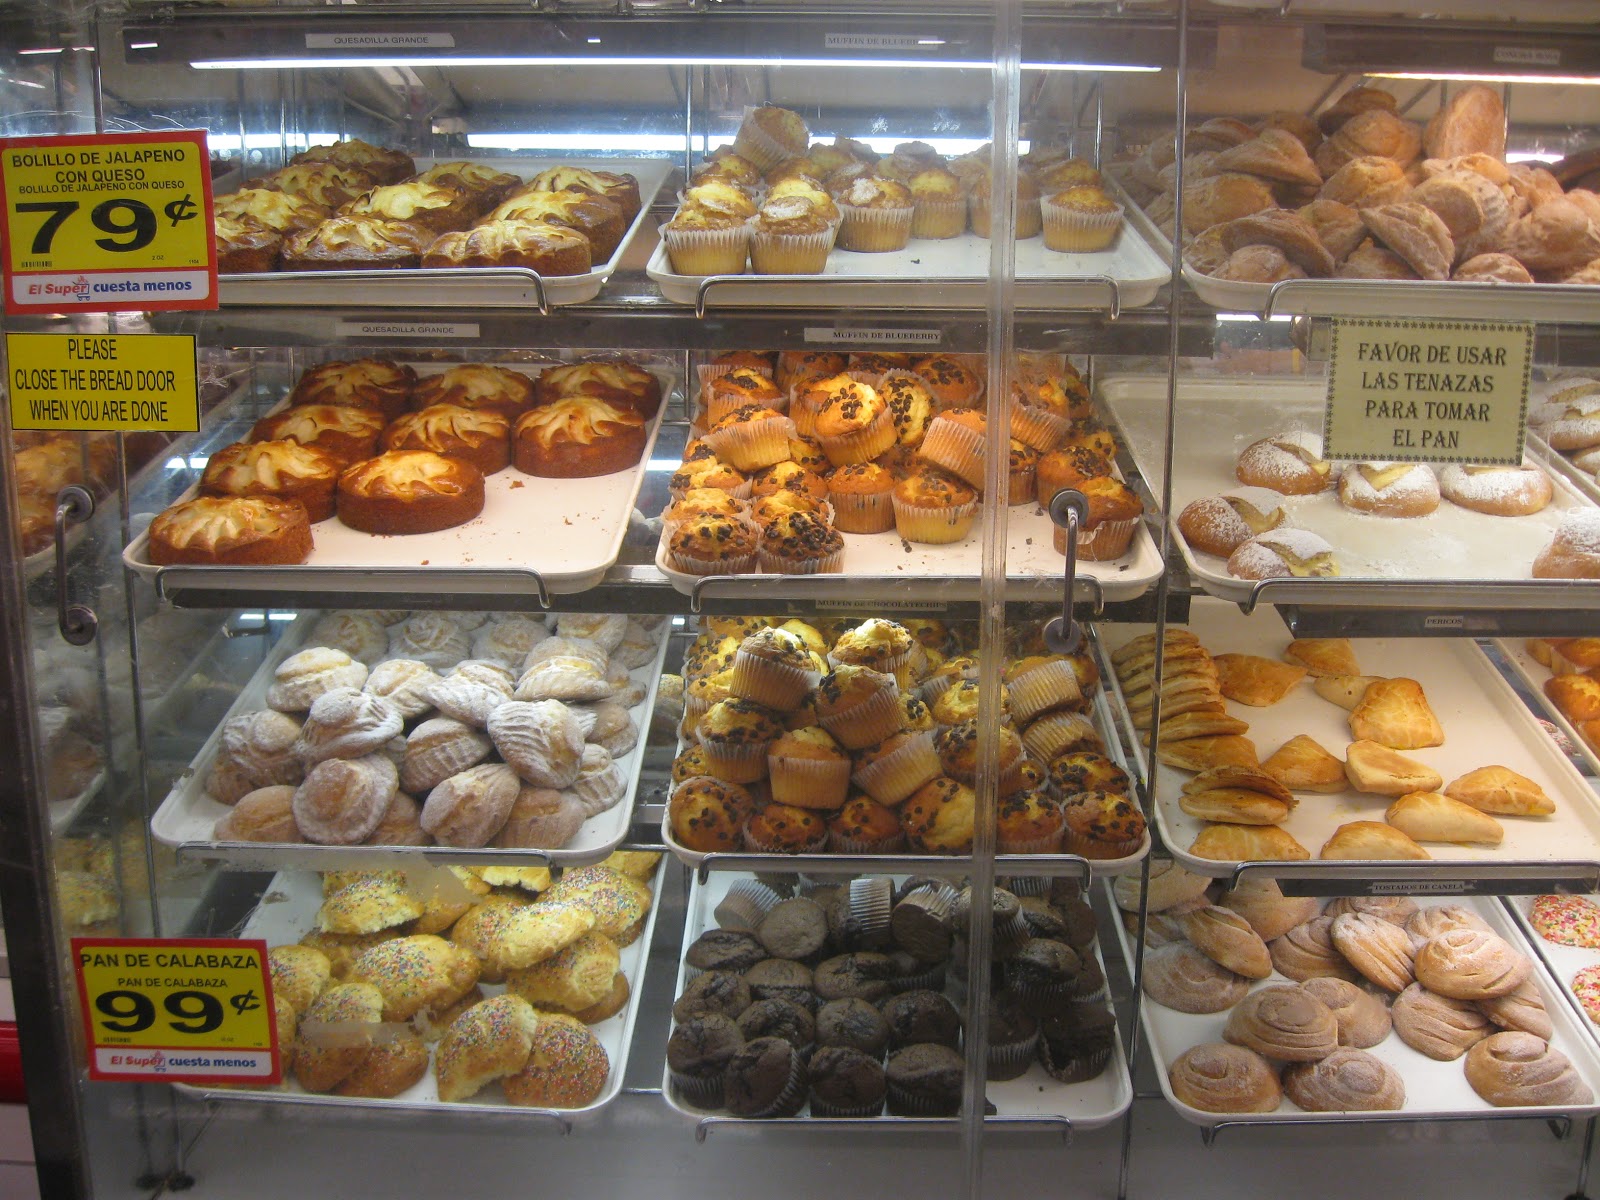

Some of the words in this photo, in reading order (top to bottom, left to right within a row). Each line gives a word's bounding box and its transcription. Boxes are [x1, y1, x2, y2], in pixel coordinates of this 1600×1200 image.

[12, 153, 76, 168] BOLILLO
[80, 152, 100, 165] DE
[105, 149, 185, 164] JALAPENO
[55, 170, 88, 184] CON
[92, 168, 145, 182] QUESO
[19, 184, 59, 194] BOLILLO
[62, 184, 74, 193] DE
[76, 182, 126, 192] JALAPENO
[129, 182, 149, 191] CON
[152, 180, 185, 190] QUESO
[28, 284, 42, 295] El
[45, 283, 87, 297] Super
[93, 281, 140, 292] cuesta
[144, 280, 192, 291] menos
[68, 338, 118, 360] PLEASE
[1358, 341, 1421, 363] FAVOR
[1427, 345, 1450, 363] DE
[1456, 346, 1506, 366] USAR
[15, 369, 58, 390] CLOSE
[61, 370, 86, 390] THE
[90, 370, 133, 391] BREAD
[137, 370, 176, 391] DOOR
[1362, 372, 1399, 390] LAS
[1404, 372, 1494, 393] TENAZAS
[30, 400, 68, 420] WHEN
[72, 400, 99, 421] YOU
[102, 401, 128, 421] ARE
[132, 401, 168, 422] DONE
[1365, 400, 1418, 419] PARA
[1425, 402, 1490, 422] TOMAR
[1393, 429, 1415, 447] EL
[1421, 430, 1459, 449] PAN
[80, 954, 119, 967] PAN
[126, 954, 150, 967] DE
[156, 954, 258, 969] CALABAZA
[118, 978, 142, 987] PAN
[146, 978, 161, 987] DE
[164, 978, 228, 988] CALABAZA
[111, 1056, 123, 1065] El
[126, 1056, 163, 1067] Super
[169, 1057, 210, 1067] cuesta
[213, 1058, 256, 1068] menos
